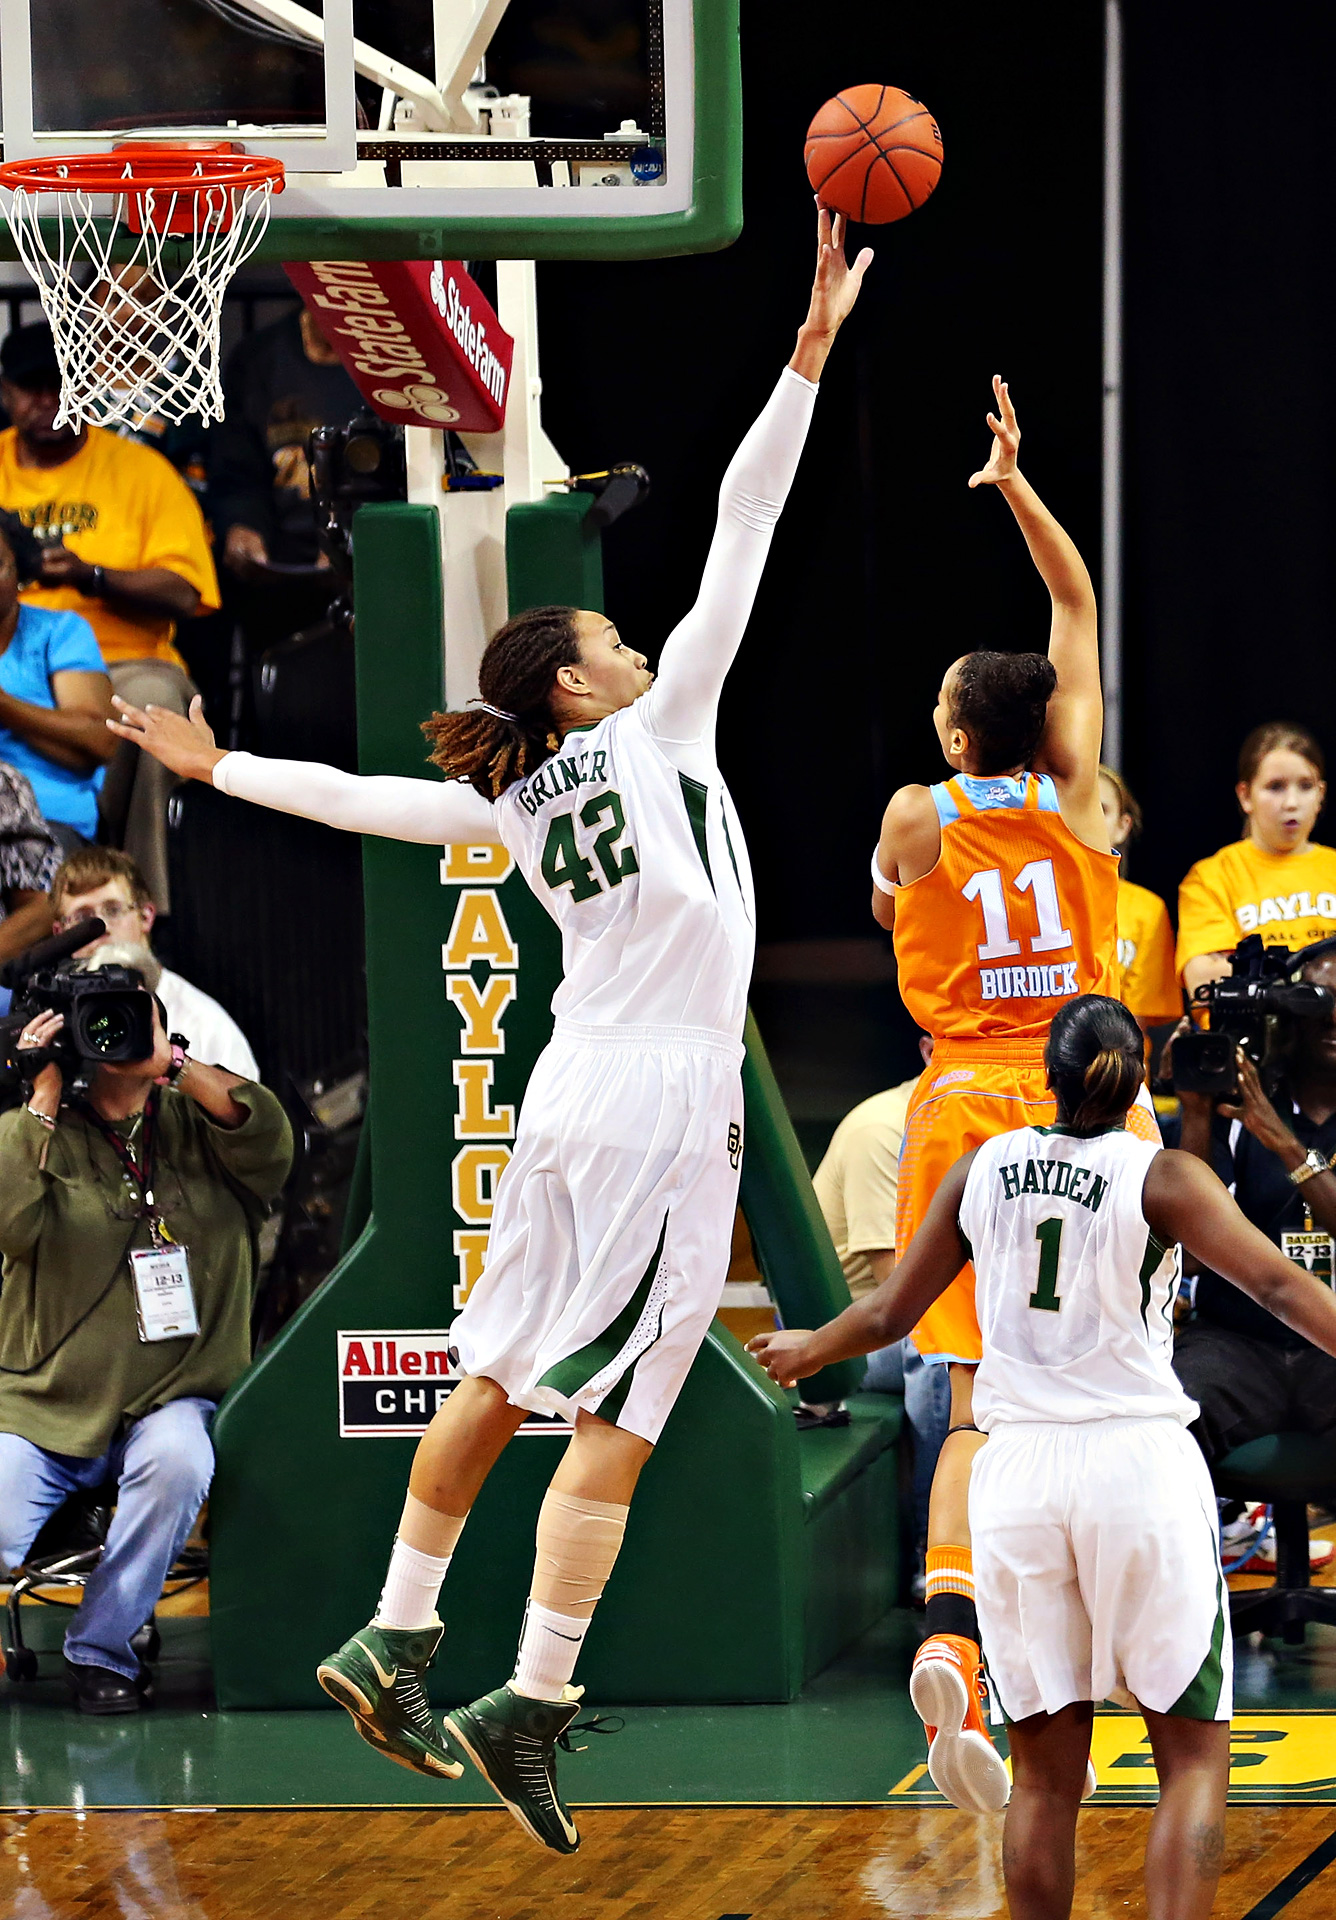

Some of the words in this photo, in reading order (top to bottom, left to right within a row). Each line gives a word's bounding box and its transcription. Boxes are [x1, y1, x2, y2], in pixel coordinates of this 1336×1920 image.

[518, 750, 607, 816] GRINER
[541, 789, 640, 904] 42
[961, 858, 1073, 960] 11
[979, 961, 1079, 1000] BURDICK
[999, 1159, 1108, 1213] HAYDEN
[1028, 1216, 1064, 1313] 1
[1286, 1235, 1329, 1244] BAYLOR
[1287, 1245, 1331, 1258] 12-13
[343, 1341, 449, 1376] Allen
